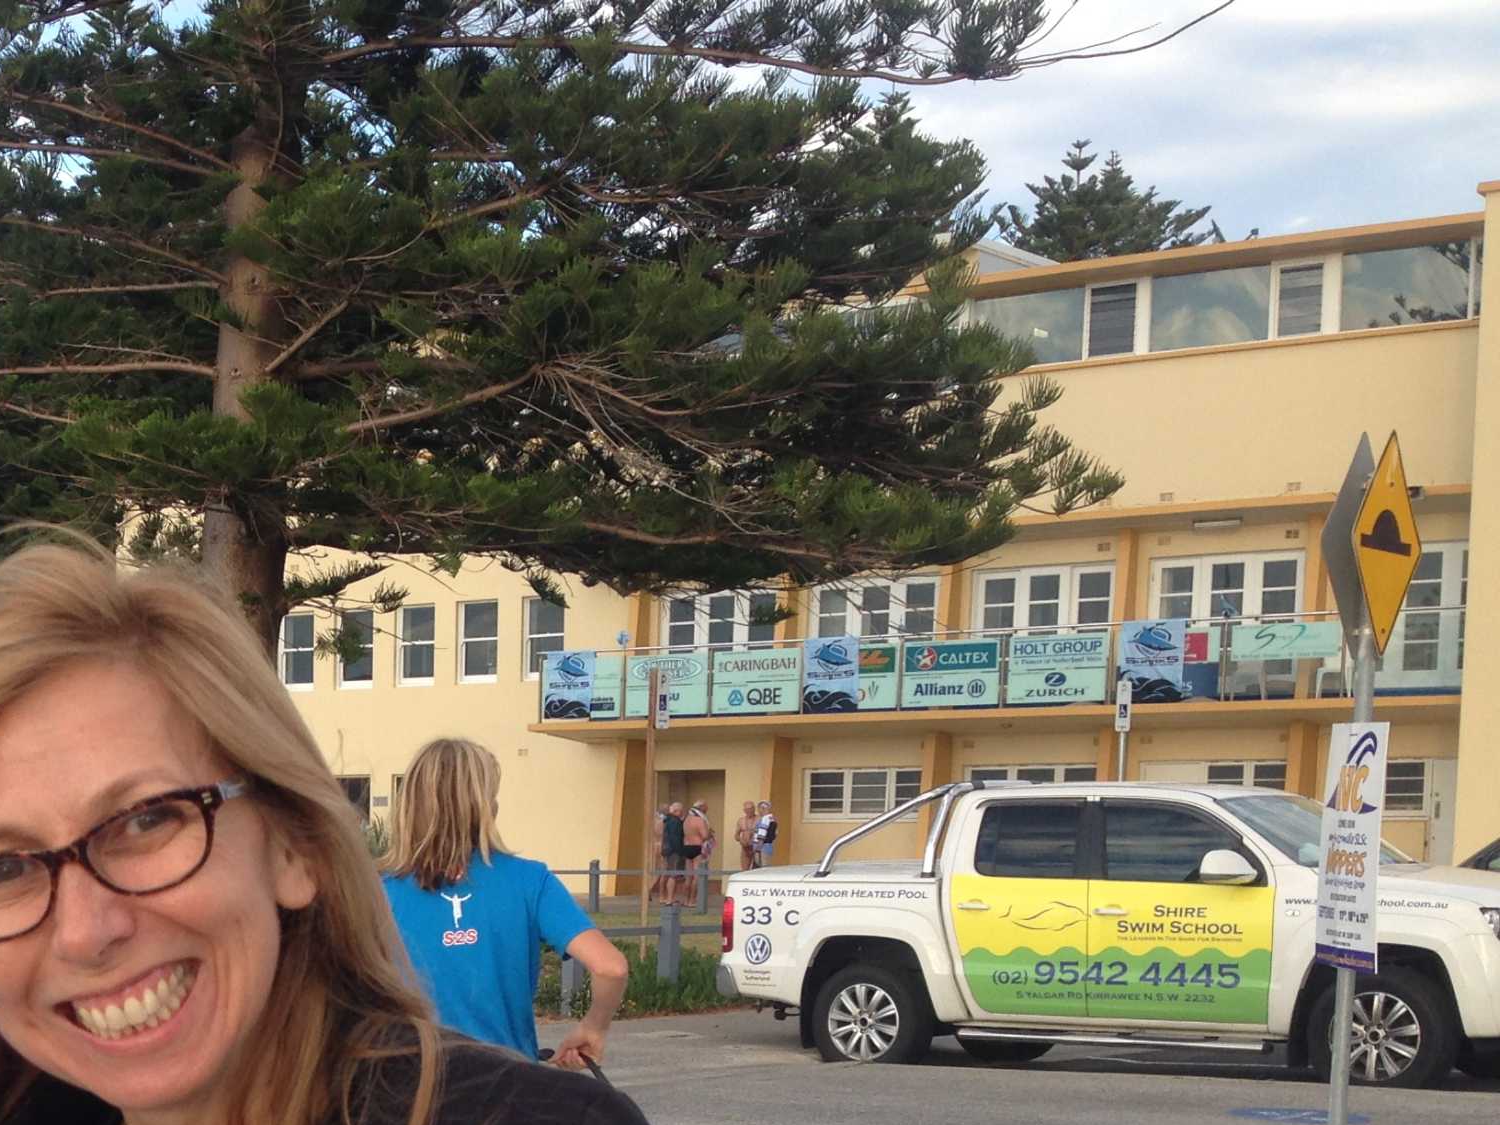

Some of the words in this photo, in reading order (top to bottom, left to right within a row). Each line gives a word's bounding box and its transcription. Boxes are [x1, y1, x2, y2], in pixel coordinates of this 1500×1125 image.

[1013, 643, 1049, 656] HOLT
[1052, 640, 1102, 654] GROUP
[724, 658, 797, 673] CARINGBAH
[939, 651, 989, 665] CALTEX
[747, 687, 783, 706] QBE
[913, 682, 964, 697] Allianz
[1025, 687, 1085, 698] ZURICH
[769, 888, 805, 898] WATER
[808, 889, 849, 898] INDOOR
[851, 889, 895, 899] HEATED
[898, 889, 928, 899] POOL
[741, 906, 772, 926] 33
[1153, 904, 1208, 919] SHIRE
[1117, 919, 1164, 934] SWIM
[1170, 920, 1243, 935] SCHOOL
[442, 928, 478, 947] S2S
[992, 969, 1028, 986] (02)
[1033, 960, 1129, 987] 9542
[1139, 961, 1241, 989] 4445
[1184, 993, 1215, 1003] 2232
